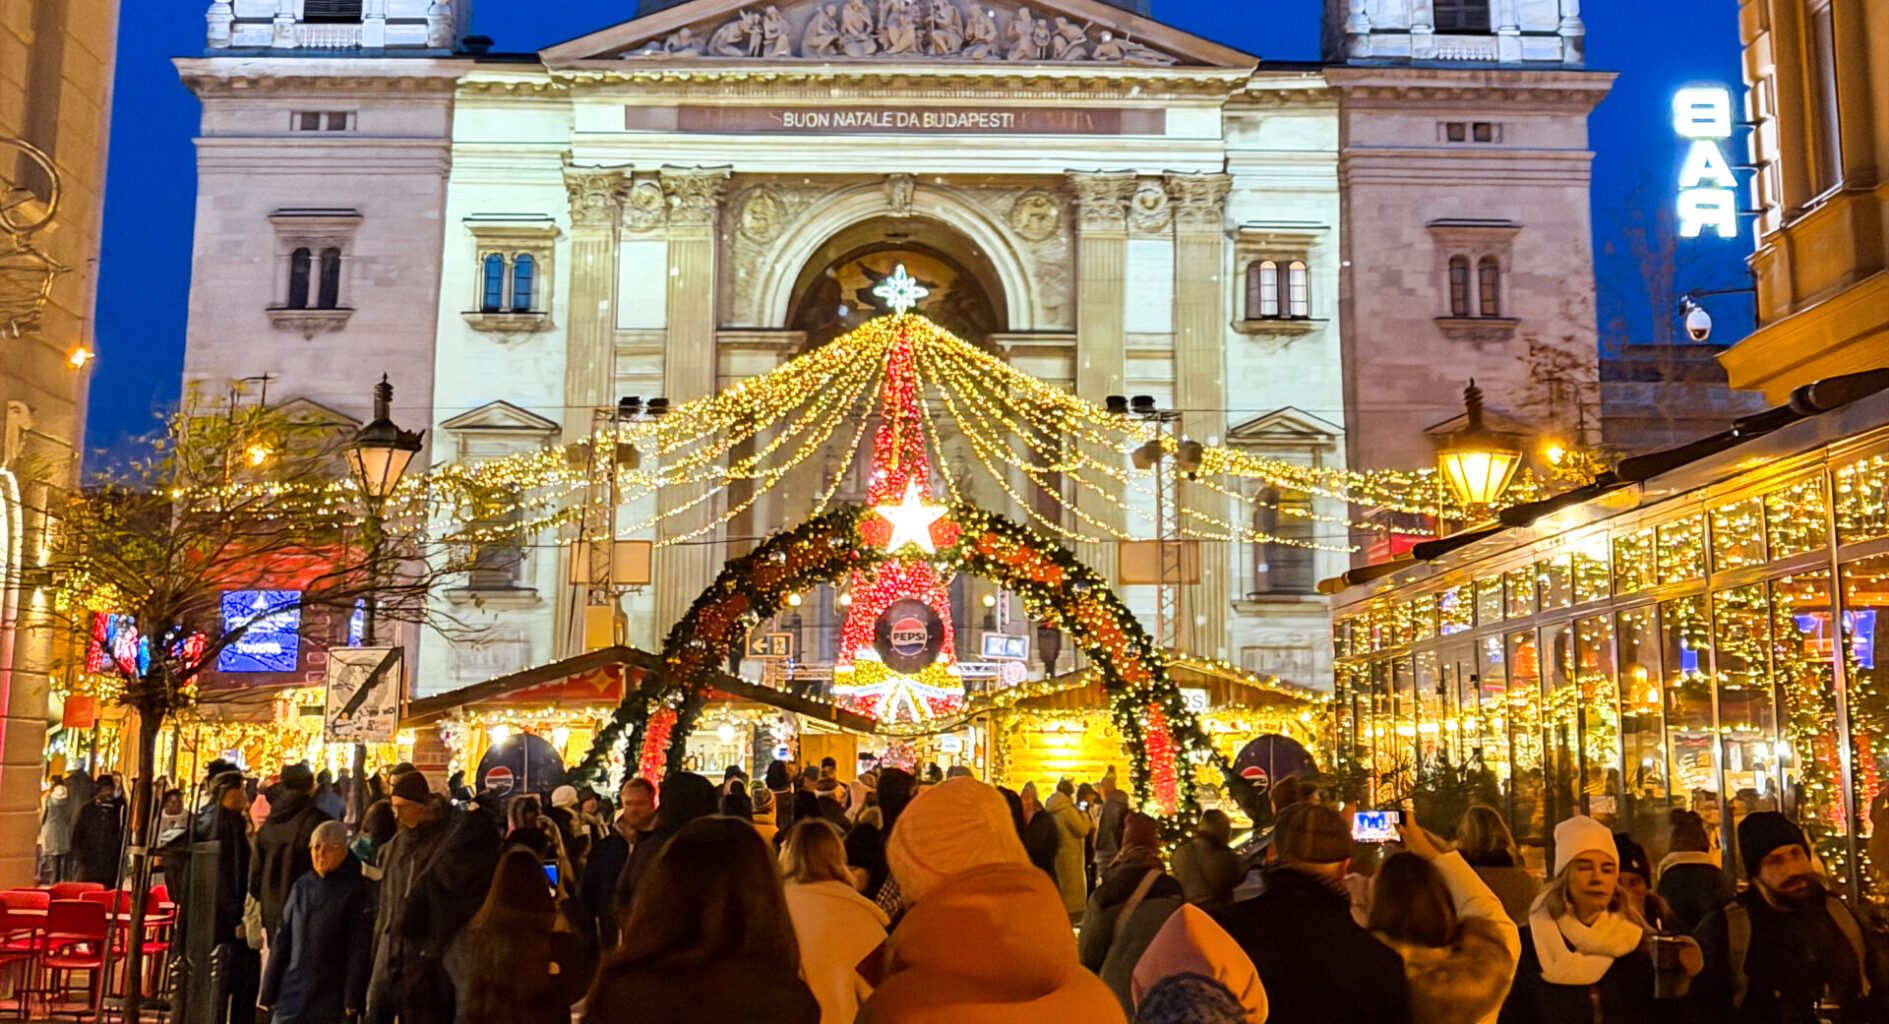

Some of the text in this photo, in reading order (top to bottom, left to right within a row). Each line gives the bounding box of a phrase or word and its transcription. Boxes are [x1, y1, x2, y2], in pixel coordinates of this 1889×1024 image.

[783, 112, 829, 127] BUON
[833, 112, 893, 127] NATALE
[897, 112, 920, 127] DA
[893, 632, 925, 641] PEPSI
